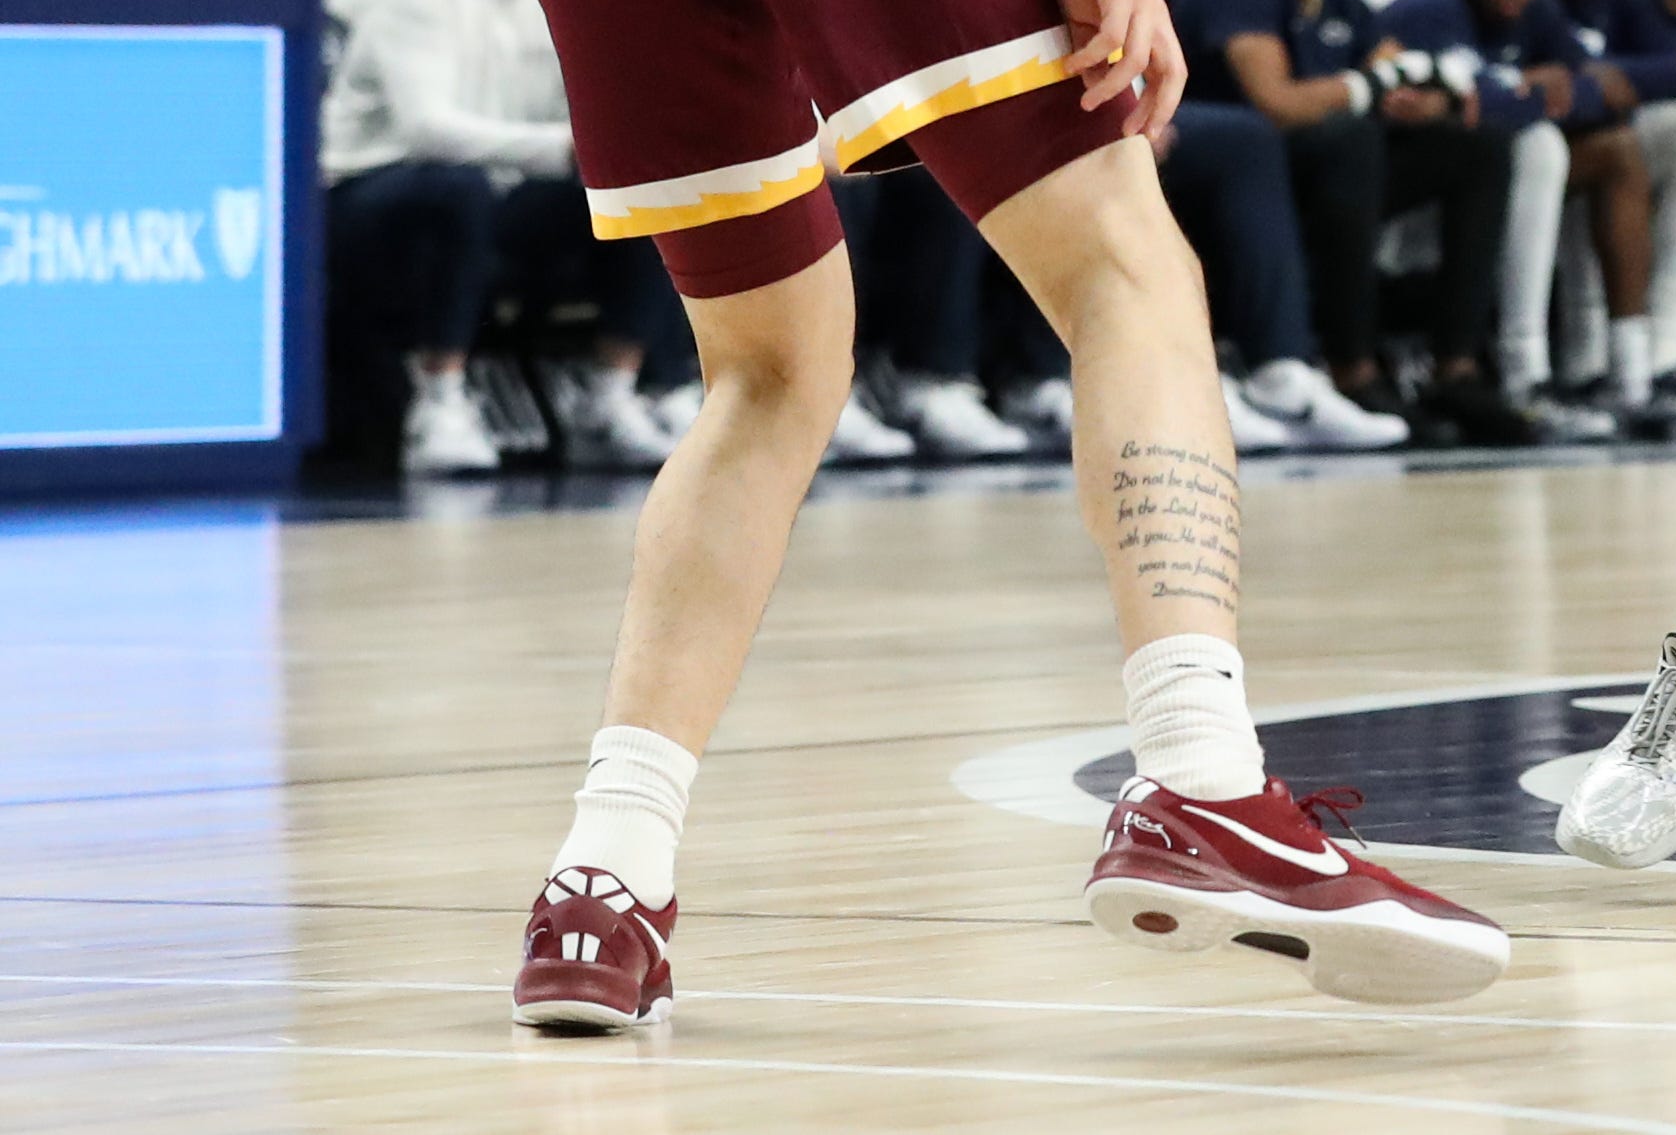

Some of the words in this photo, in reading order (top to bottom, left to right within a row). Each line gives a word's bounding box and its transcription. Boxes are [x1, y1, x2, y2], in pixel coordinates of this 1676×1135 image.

[1113, 470, 1138, 492] Do
[1142, 473, 1164, 486] not
[1167, 468, 1184, 487] be
[1137, 495, 1157, 516] the
